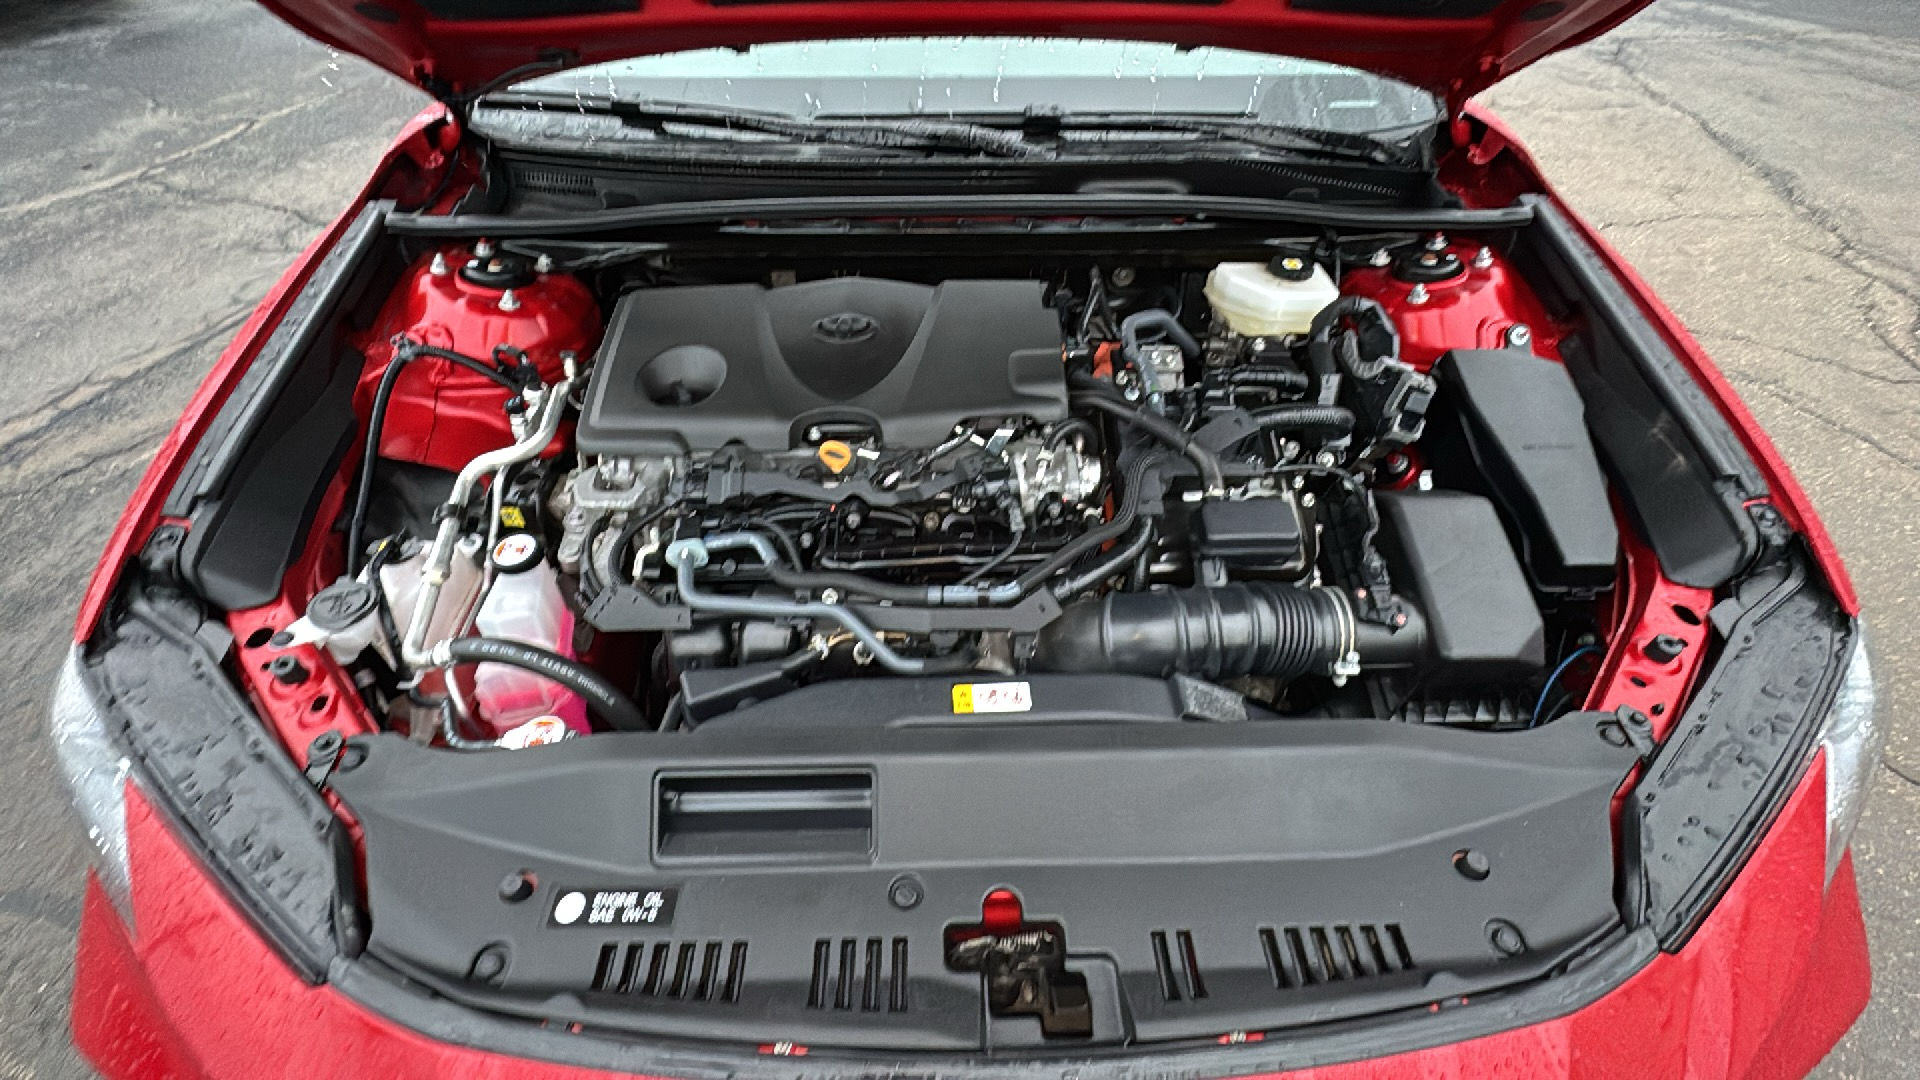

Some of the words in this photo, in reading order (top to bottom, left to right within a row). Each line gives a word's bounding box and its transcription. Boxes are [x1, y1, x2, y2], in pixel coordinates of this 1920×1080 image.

[592, 891, 639, 908] ENGINE
[643, 891, 665, 908] OIL
[588, 907, 616, 924] SAE
